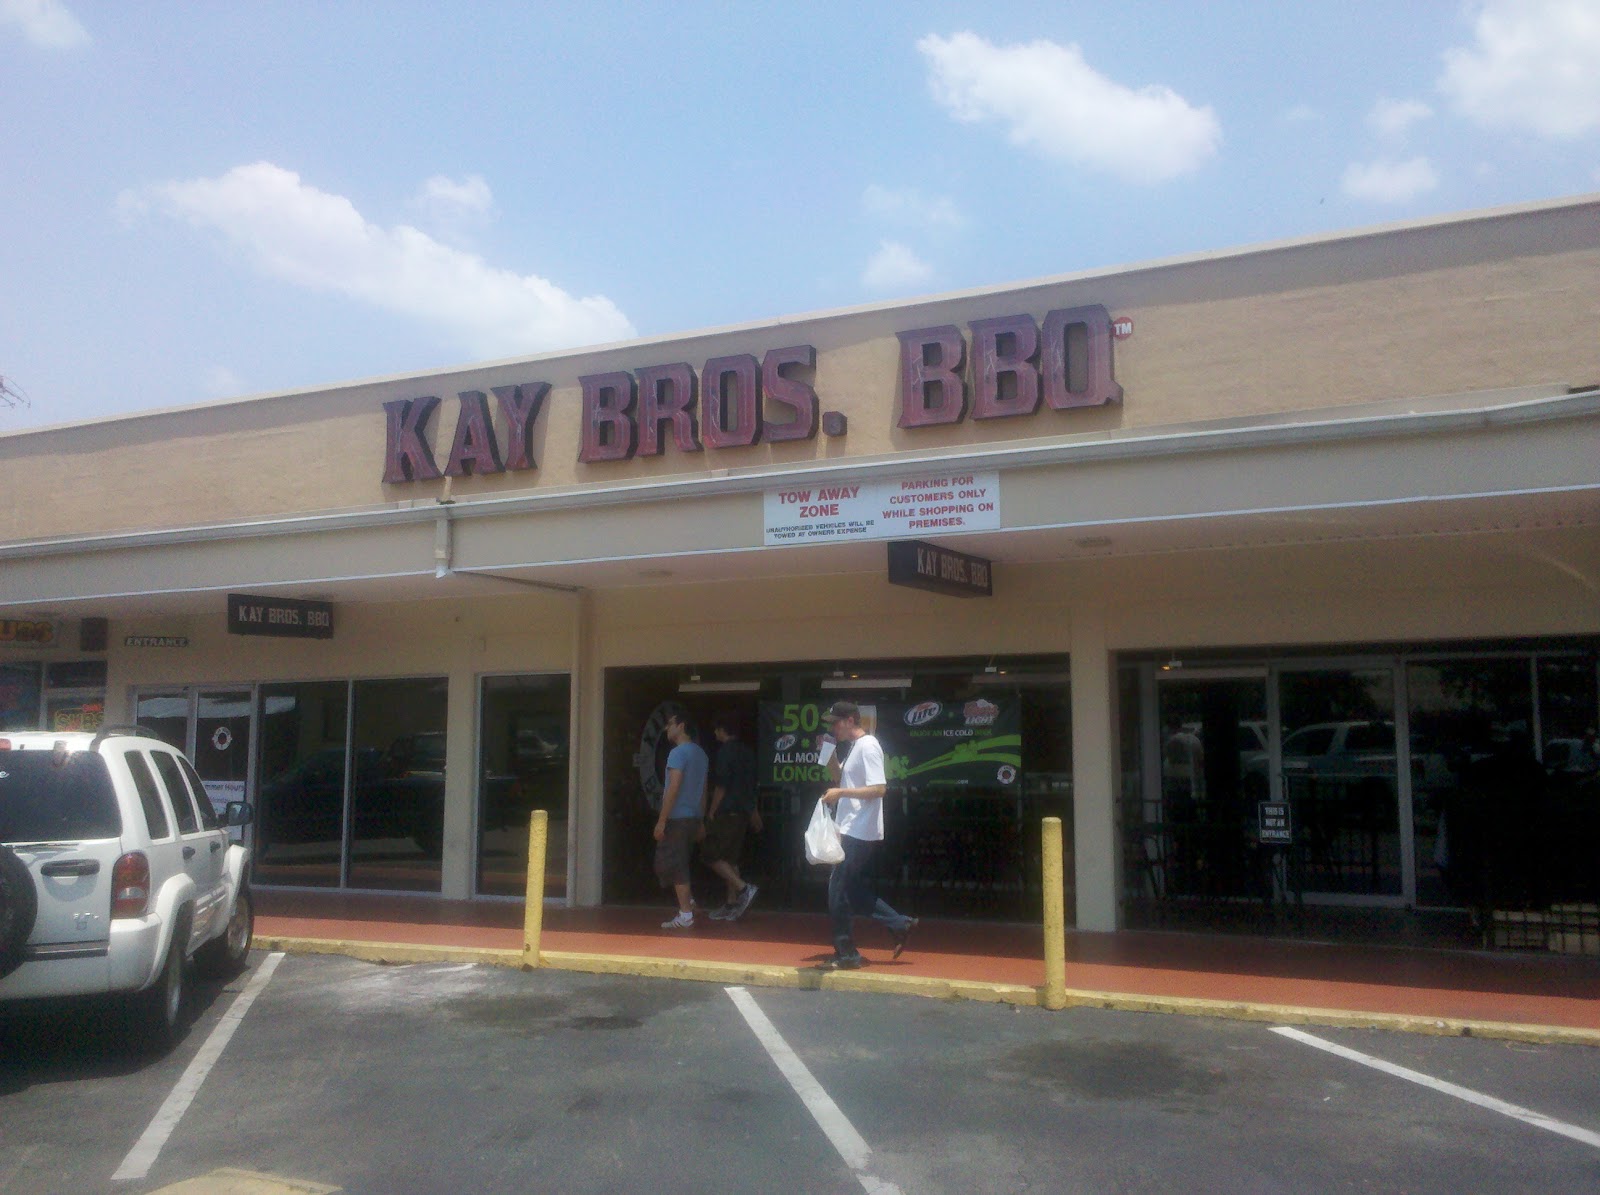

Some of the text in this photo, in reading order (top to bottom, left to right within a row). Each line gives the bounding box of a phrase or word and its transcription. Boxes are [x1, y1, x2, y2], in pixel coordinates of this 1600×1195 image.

[1113, 321, 1132, 336] TM
[382, 303, 1123, 484] KAY BROS. BBQ
[901, 475, 974, 491] PARKING FOR
[779, 485, 860, 504] TOW AWAY
[890, 488, 987, 505] CUSTOMERS ONLY
[800, 503, 839, 518] ZONE
[882, 502, 994, 519] WHILE SHOPPING ON
[815, 522, 846, 530] VEHICLES
[909, 517, 965, 530] PREMISES.
[807, 529, 835, 537] OWNERS
[837, 526, 867, 535] EXPENSE
[917, 547, 937, 576] KAY
[238, 605, 263, 623] KAY
[268, 607, 302, 625] BROS.
[125, 637, 188, 648] ENTRANCE
[943, 729, 954, 737] ICE
[954, 729, 974, 737] COLD
[773, 752, 819, 764] ALL MON
